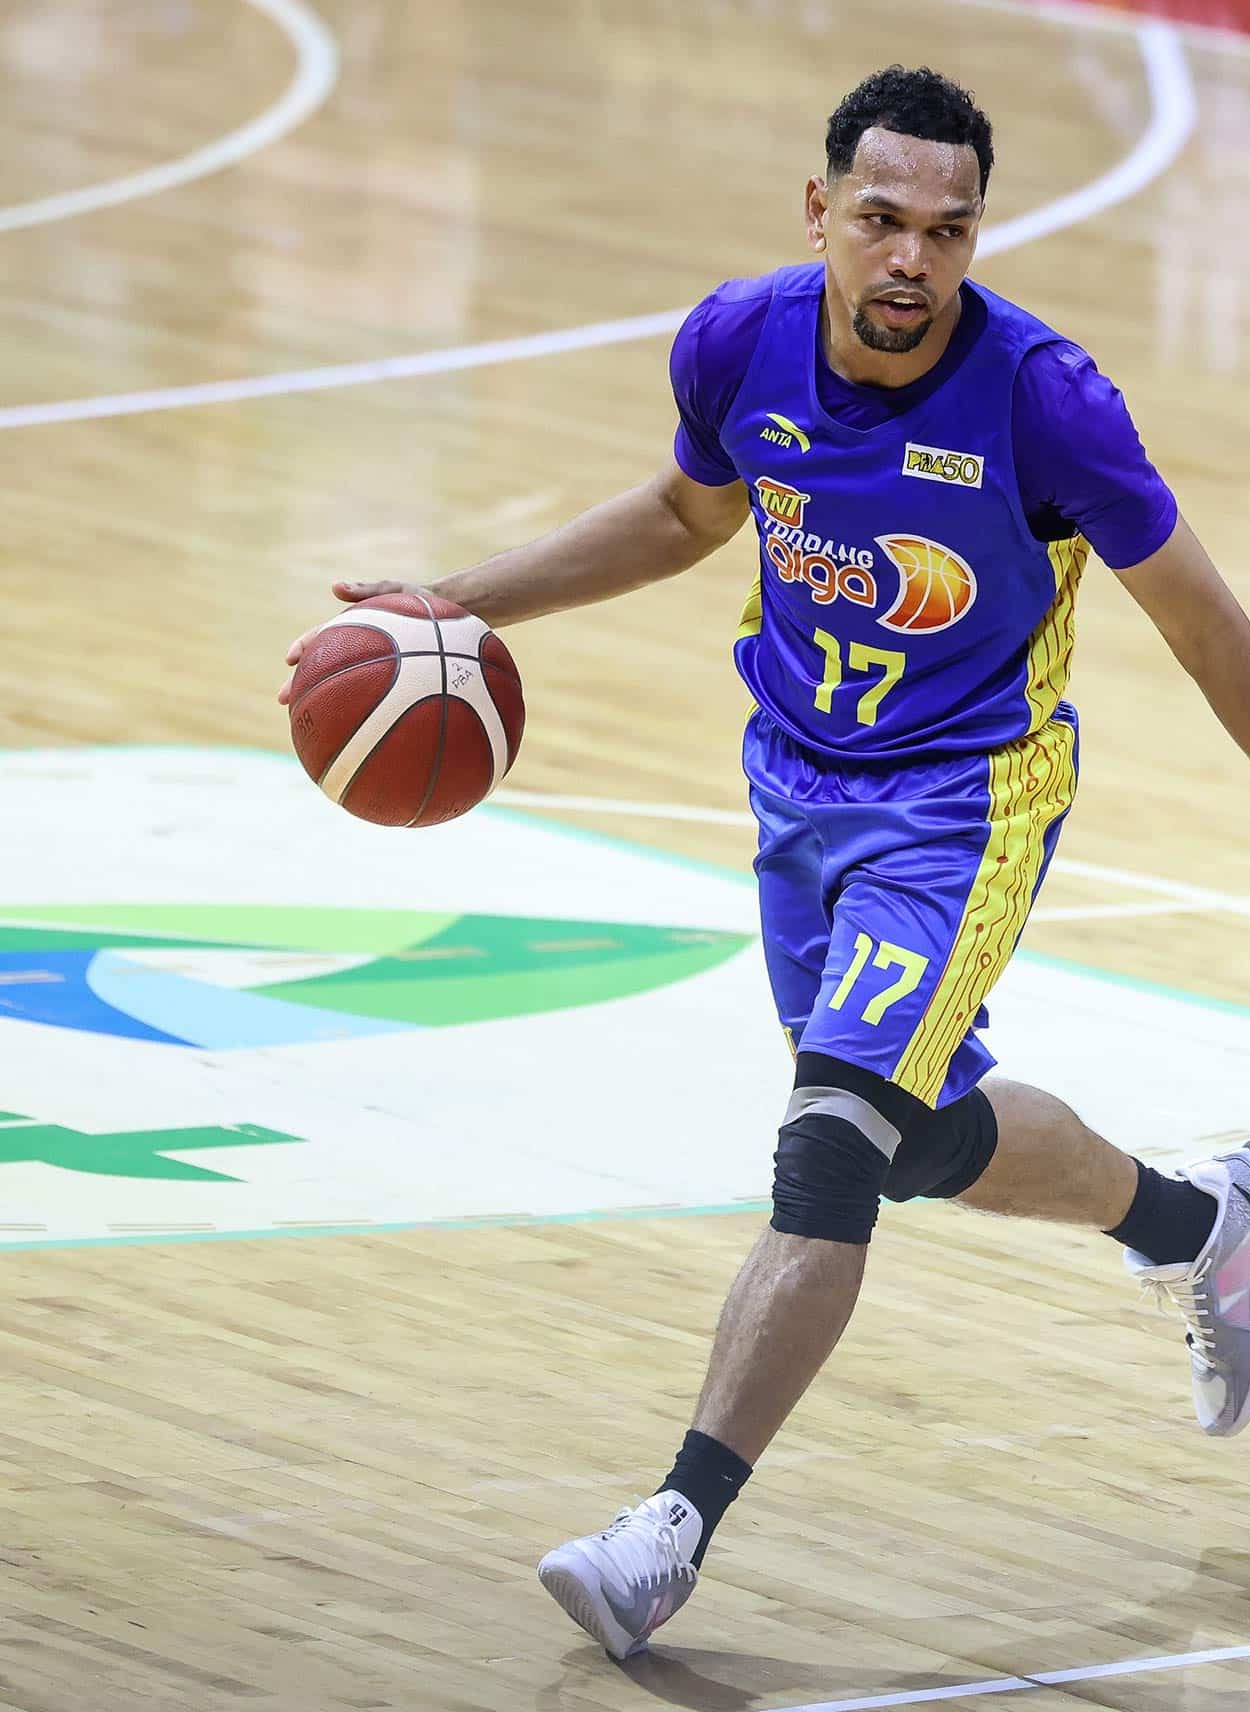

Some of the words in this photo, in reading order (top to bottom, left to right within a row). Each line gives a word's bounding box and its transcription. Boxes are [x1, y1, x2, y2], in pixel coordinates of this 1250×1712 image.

[759, 427, 792, 449] ANTA
[759, 486, 809, 519] TNT
[813, 627, 906, 727] 17
[828, 932, 930, 1026] 17
